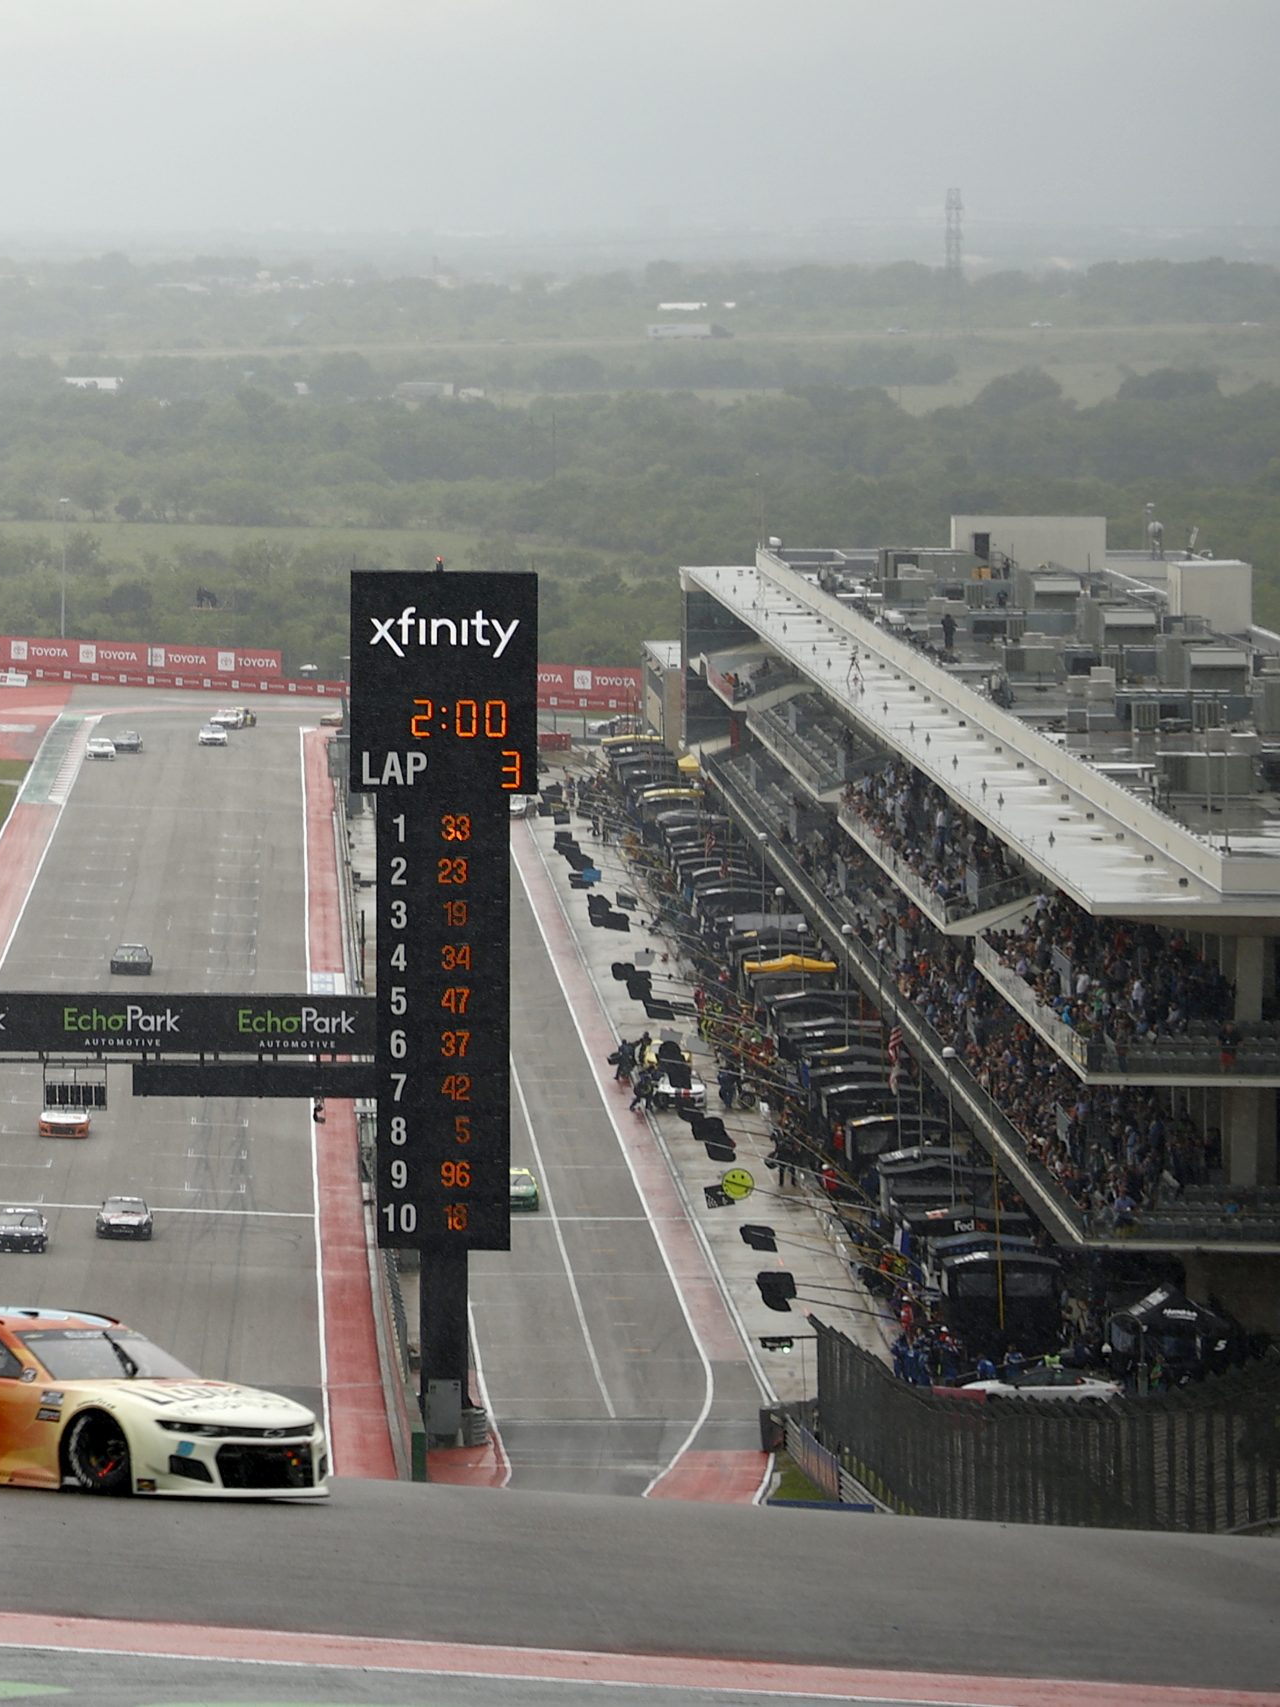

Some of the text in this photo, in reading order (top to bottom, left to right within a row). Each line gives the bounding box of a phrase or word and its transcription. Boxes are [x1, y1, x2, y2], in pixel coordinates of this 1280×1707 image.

[370, 606, 520, 658] xfinity
[30, 646, 69, 658] TOYOTA
[99, 650, 137, 661] TOYOTA
[168, 653, 207, 665] TOYOTA
[238, 657, 278, 668] TOYOTA
[537, 673, 563, 683] YOTA
[595, 676, 636, 687] TOYOTA
[411, 699, 508, 738] 2:00
[362, 751, 521, 789] LAP 3
[393, 814, 471, 842] 1 33
[390, 857, 468, 885] 2 23
[390, 900, 468, 929] 3 19
[390, 943, 470, 972] 4 34
[390, 986, 470, 1015] 5 47
[64, 1005, 180, 1032] EchoPark
[238, 1007, 356, 1034] EchoPark
[84, 1038, 161, 1046] AUTOMOTIVE
[259, 1040, 336, 1049] AUTOMOTIVE
[390, 1029, 470, 1059] 6 37
[390, 1073, 471, 1102] 7 42
[390, 1116, 470, 1145] 8 5
[390, 1160, 470, 1189] 9 96
[382, 1203, 417, 1232] 10
